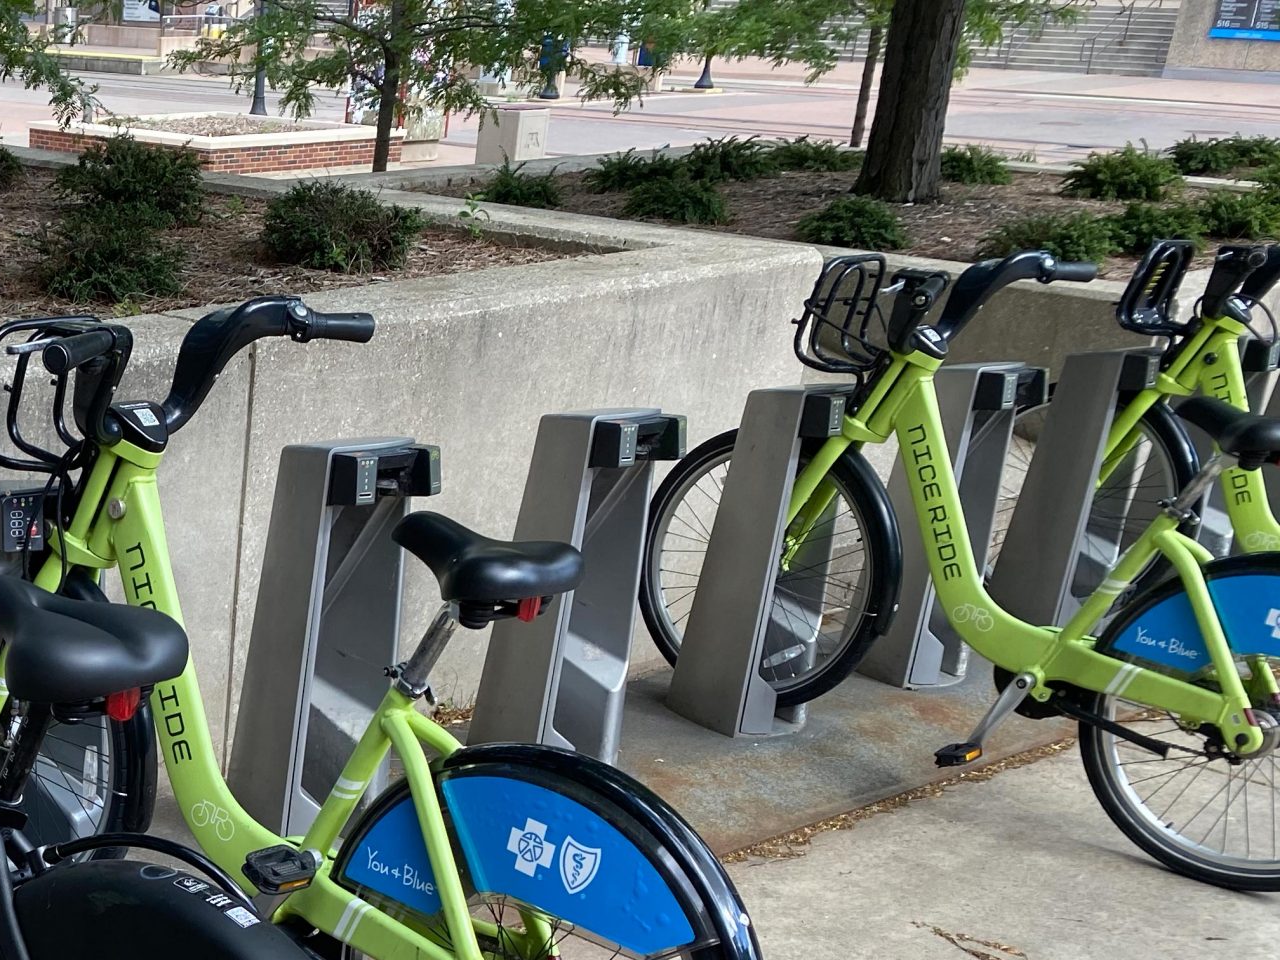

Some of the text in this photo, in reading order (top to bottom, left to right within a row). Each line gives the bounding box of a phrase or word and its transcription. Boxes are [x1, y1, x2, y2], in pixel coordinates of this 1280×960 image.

[907, 423, 962, 581] NICE RIDE
[1135, 626, 1156, 646] You
[1168, 637, 1198, 660] Blue
[158, 684, 192, 765] IDE
[367, 846, 389, 876] You
[402, 863, 434, 895] Blue
